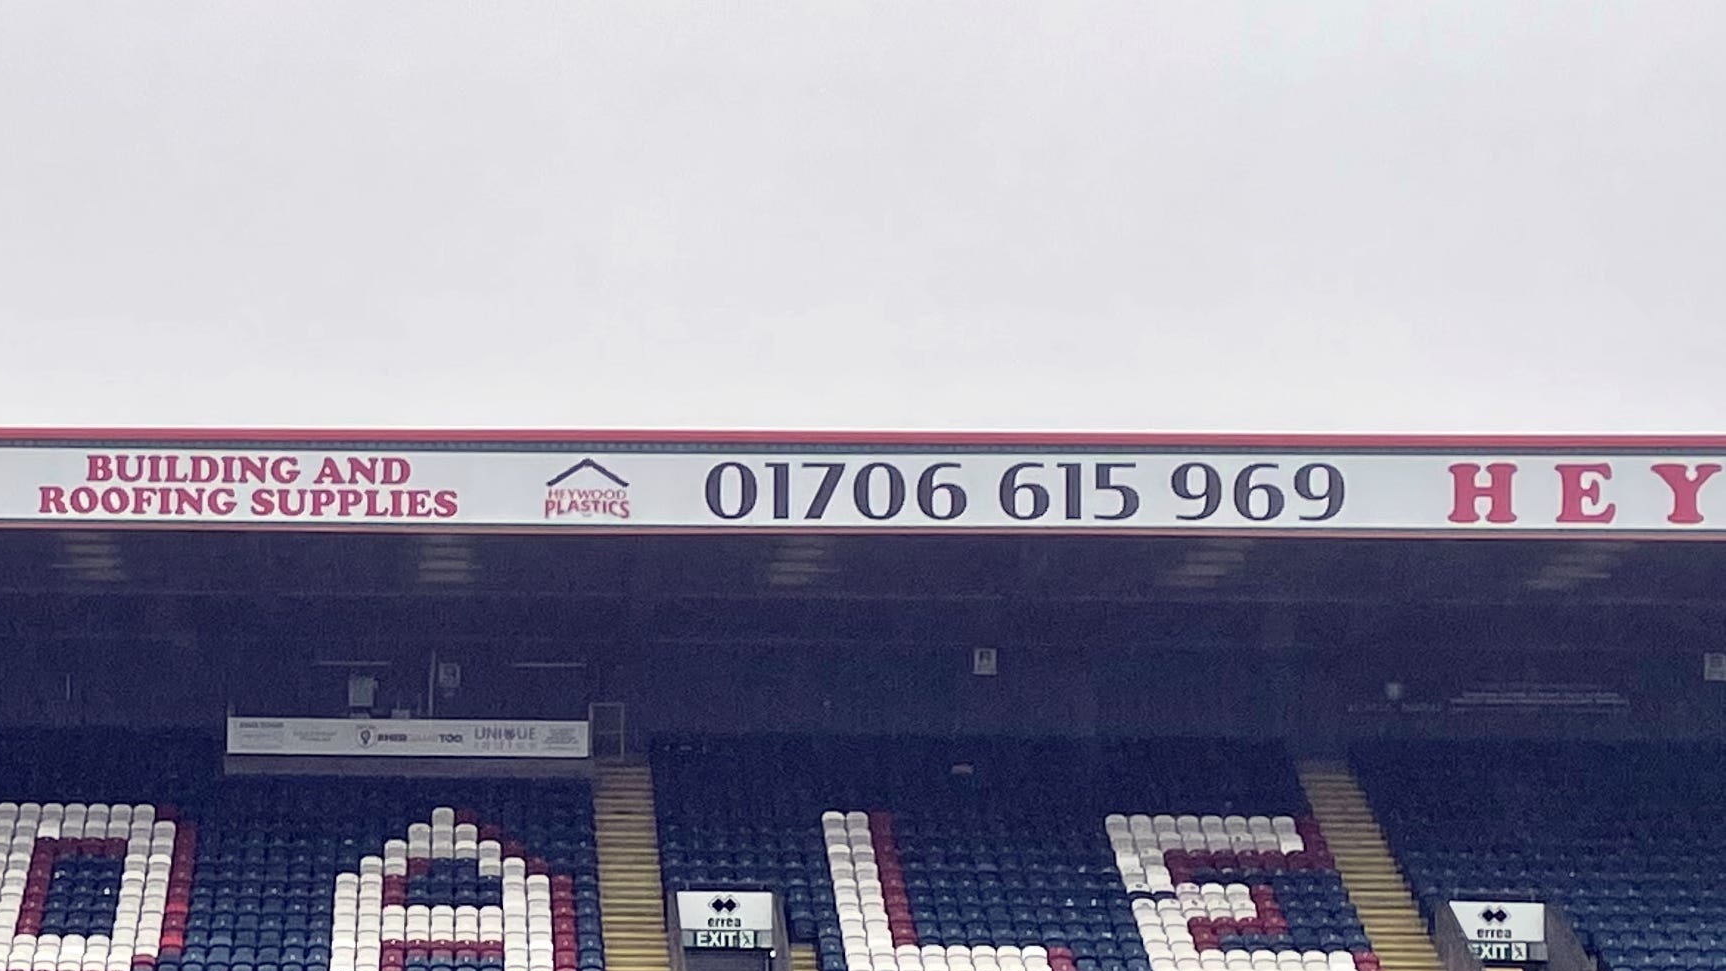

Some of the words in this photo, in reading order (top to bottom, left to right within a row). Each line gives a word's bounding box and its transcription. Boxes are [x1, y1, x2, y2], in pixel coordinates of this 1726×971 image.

[86, 455, 300, 484] BUILDING
[313, 456, 411, 485] AND
[38, 486, 237, 515] ROOFING
[250, 488, 458, 517] SUPPLIES
[548, 489, 627, 500] HEYWOOD
[704, 461, 968, 522] 01706
[998, 461, 1142, 522] 615
[1169, 461, 1346, 522] 969
[1448, 462, 1723, 524] HEY
[545, 499, 630, 519] PLASTICS
[696, 931, 737, 947] EXIT
